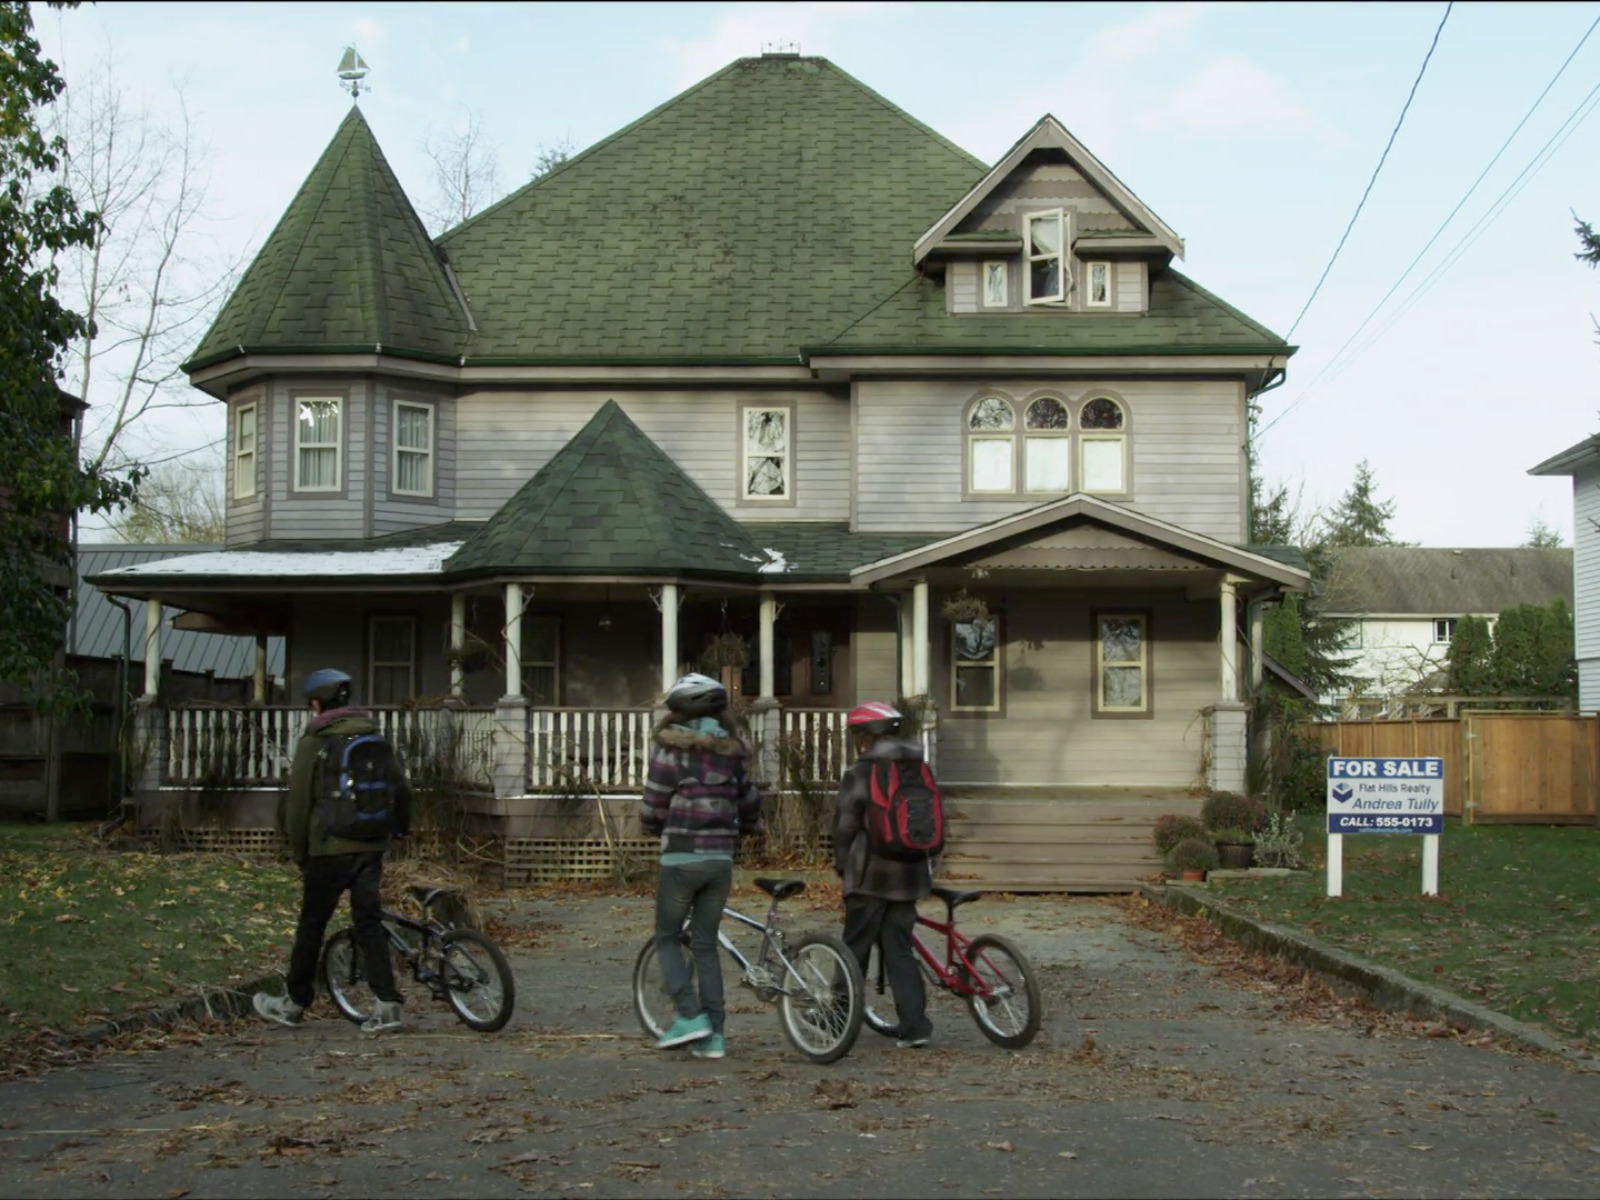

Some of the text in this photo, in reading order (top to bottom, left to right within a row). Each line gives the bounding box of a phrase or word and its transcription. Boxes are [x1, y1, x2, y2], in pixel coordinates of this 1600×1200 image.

[1333, 761, 1439, 776] FOR SALE
[1359, 783, 1431, 795] Flat Hills Realty
[1352, 798, 1439, 812] Andrea Tully
[1340, 817, 1433, 827] CALL: 555-0173
